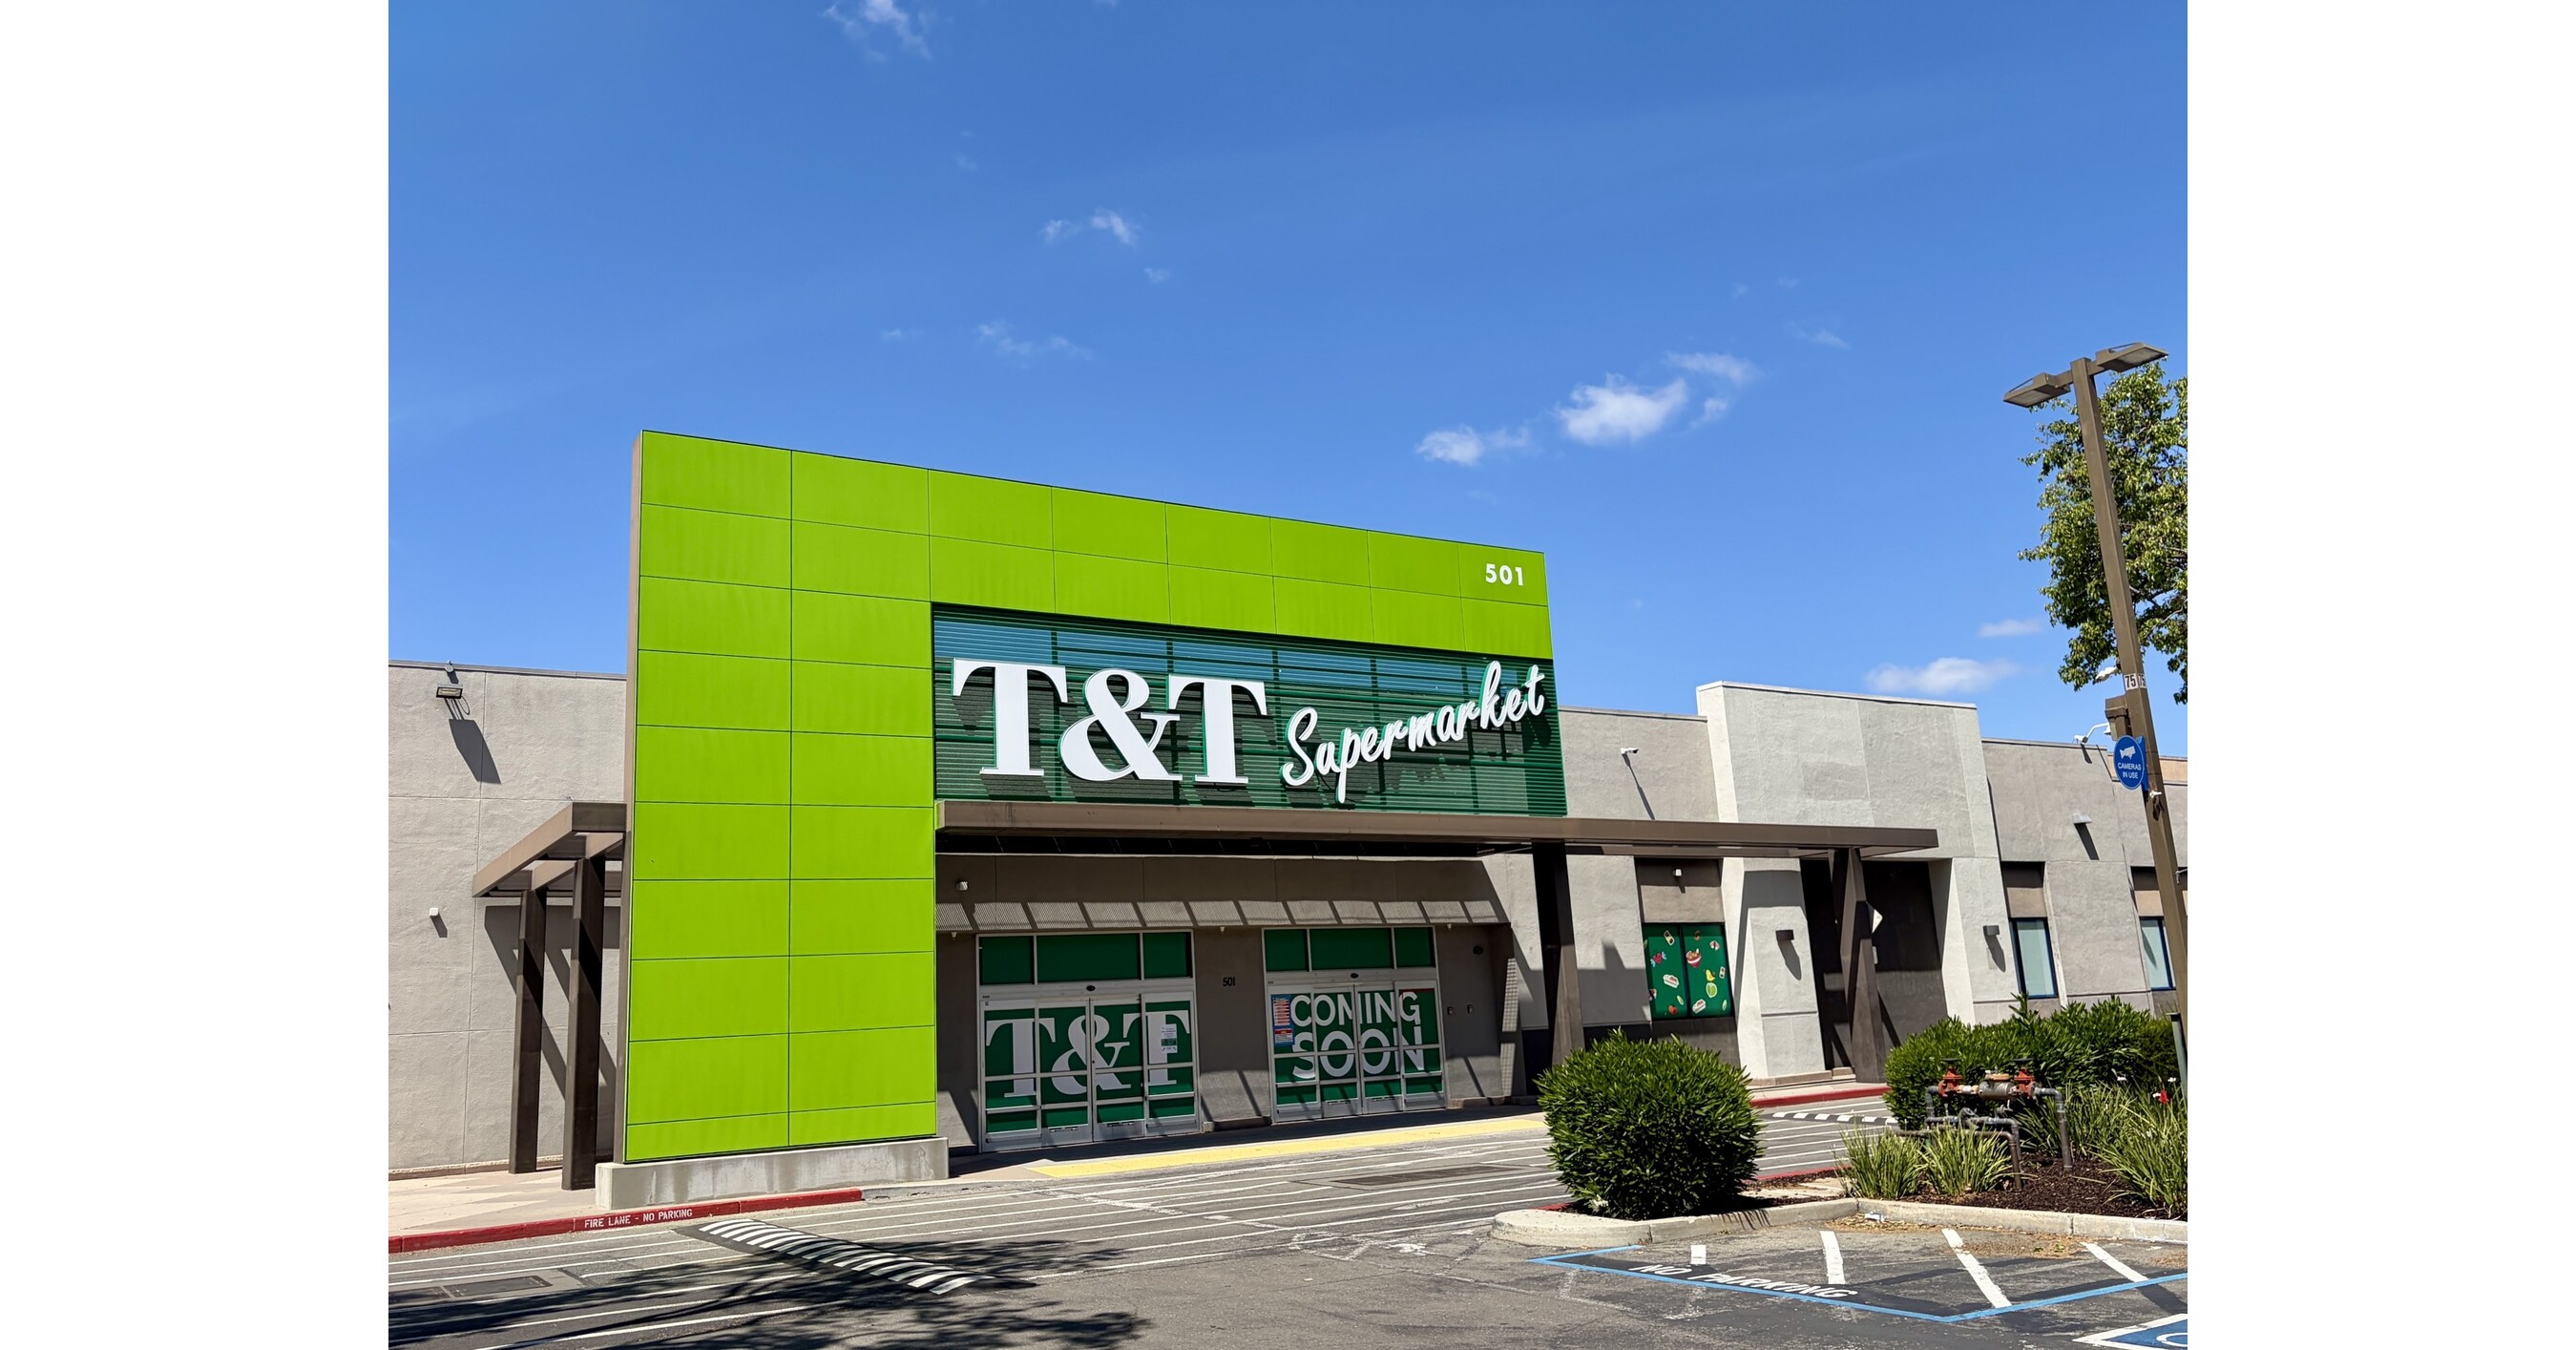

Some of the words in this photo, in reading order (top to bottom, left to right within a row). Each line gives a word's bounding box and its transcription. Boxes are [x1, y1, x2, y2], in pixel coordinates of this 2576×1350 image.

[1485, 562, 1524, 586] 501
[2125, 674, 2136, 687] 75
[952, 658, 1267, 783] T&T
[1280, 660, 1545, 804] Supermarket
[2118, 763, 2142, 771] CAMERAS
[1223, 976, 1236, 986] 501
[1290, 991, 1421, 1027] COMING
[986, 1009, 1190, 1098] T&T
[1291, 1024, 1425, 1080] SOON
[584, 1217, 604, 1229] FIRE
[608, 1214, 631, 1227] LANE
[642, 1213, 655, 1222] NO
[659, 1209, 693, 1220] PARKING
[1628, 1264, 1692, 1276] NO
[1687, 1273, 1858, 1297] PARKING
